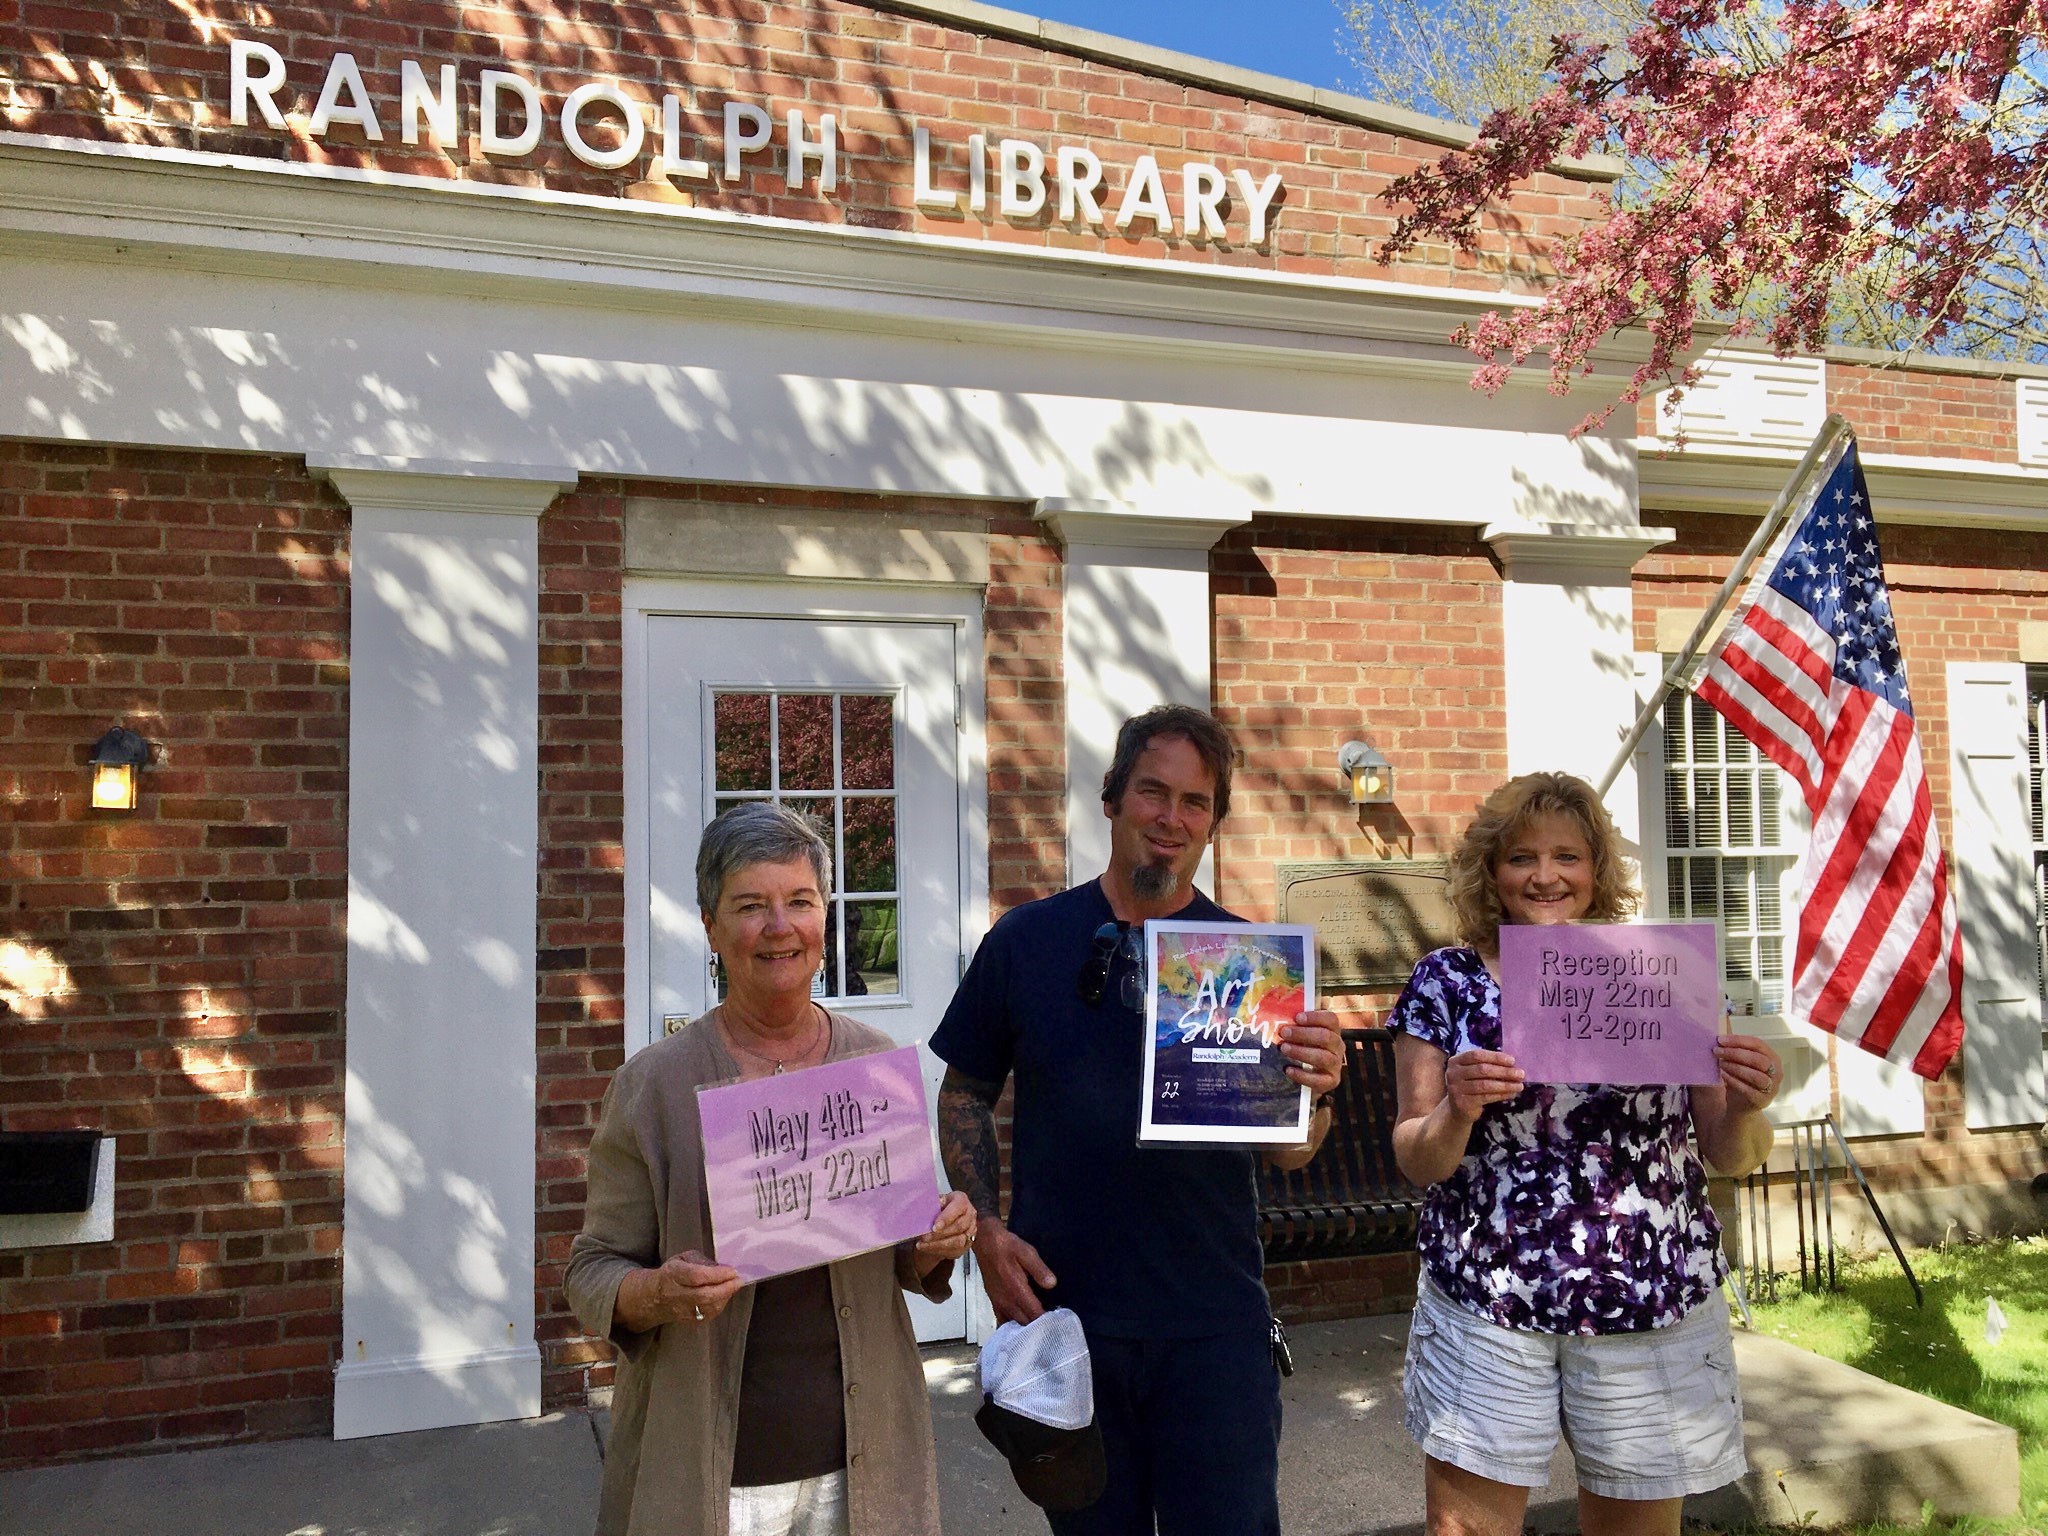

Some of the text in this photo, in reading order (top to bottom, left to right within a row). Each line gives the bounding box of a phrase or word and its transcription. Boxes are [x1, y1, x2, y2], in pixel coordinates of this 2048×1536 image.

[230, 38, 1283, 244] RANDOLPH LIBRARY
[1294, 889, 1309, 899] THE
[1312, 888, 1348, 899] ORIGINAL
[1414, 885, 1447, 896] LIBRARY
[1335, 900, 1352, 909] WAS
[1357, 899, 1394, 908] FOUNDED
[1320, 910, 1361, 922] ALBERT
[1326, 925, 1349, 934] LATER
[1354, 924, 1377, 933] GIVEN
[1172, 942, 1287, 965] Randolph Library Presents
[1324, 936, 1356, 945] VILLAGE
[1360, 935, 1371, 944] OF
[1540, 947, 1678, 981] Reception
[1194, 968, 1265, 1017] Art
[1539, 979, 1672, 1013] May 22nd
[1178, 1007, 1289, 1049] Show
[1561, 1012, 1662, 1046] 12-2pm
[1192, 1052, 1258, 1061] Randolph Academy
[1161, 1081, 1180, 1099] 22
[747, 1105, 809, 1162] May
[818, 1088, 864, 1141] 4th
[753, 1139, 891, 1221] May 22nd
